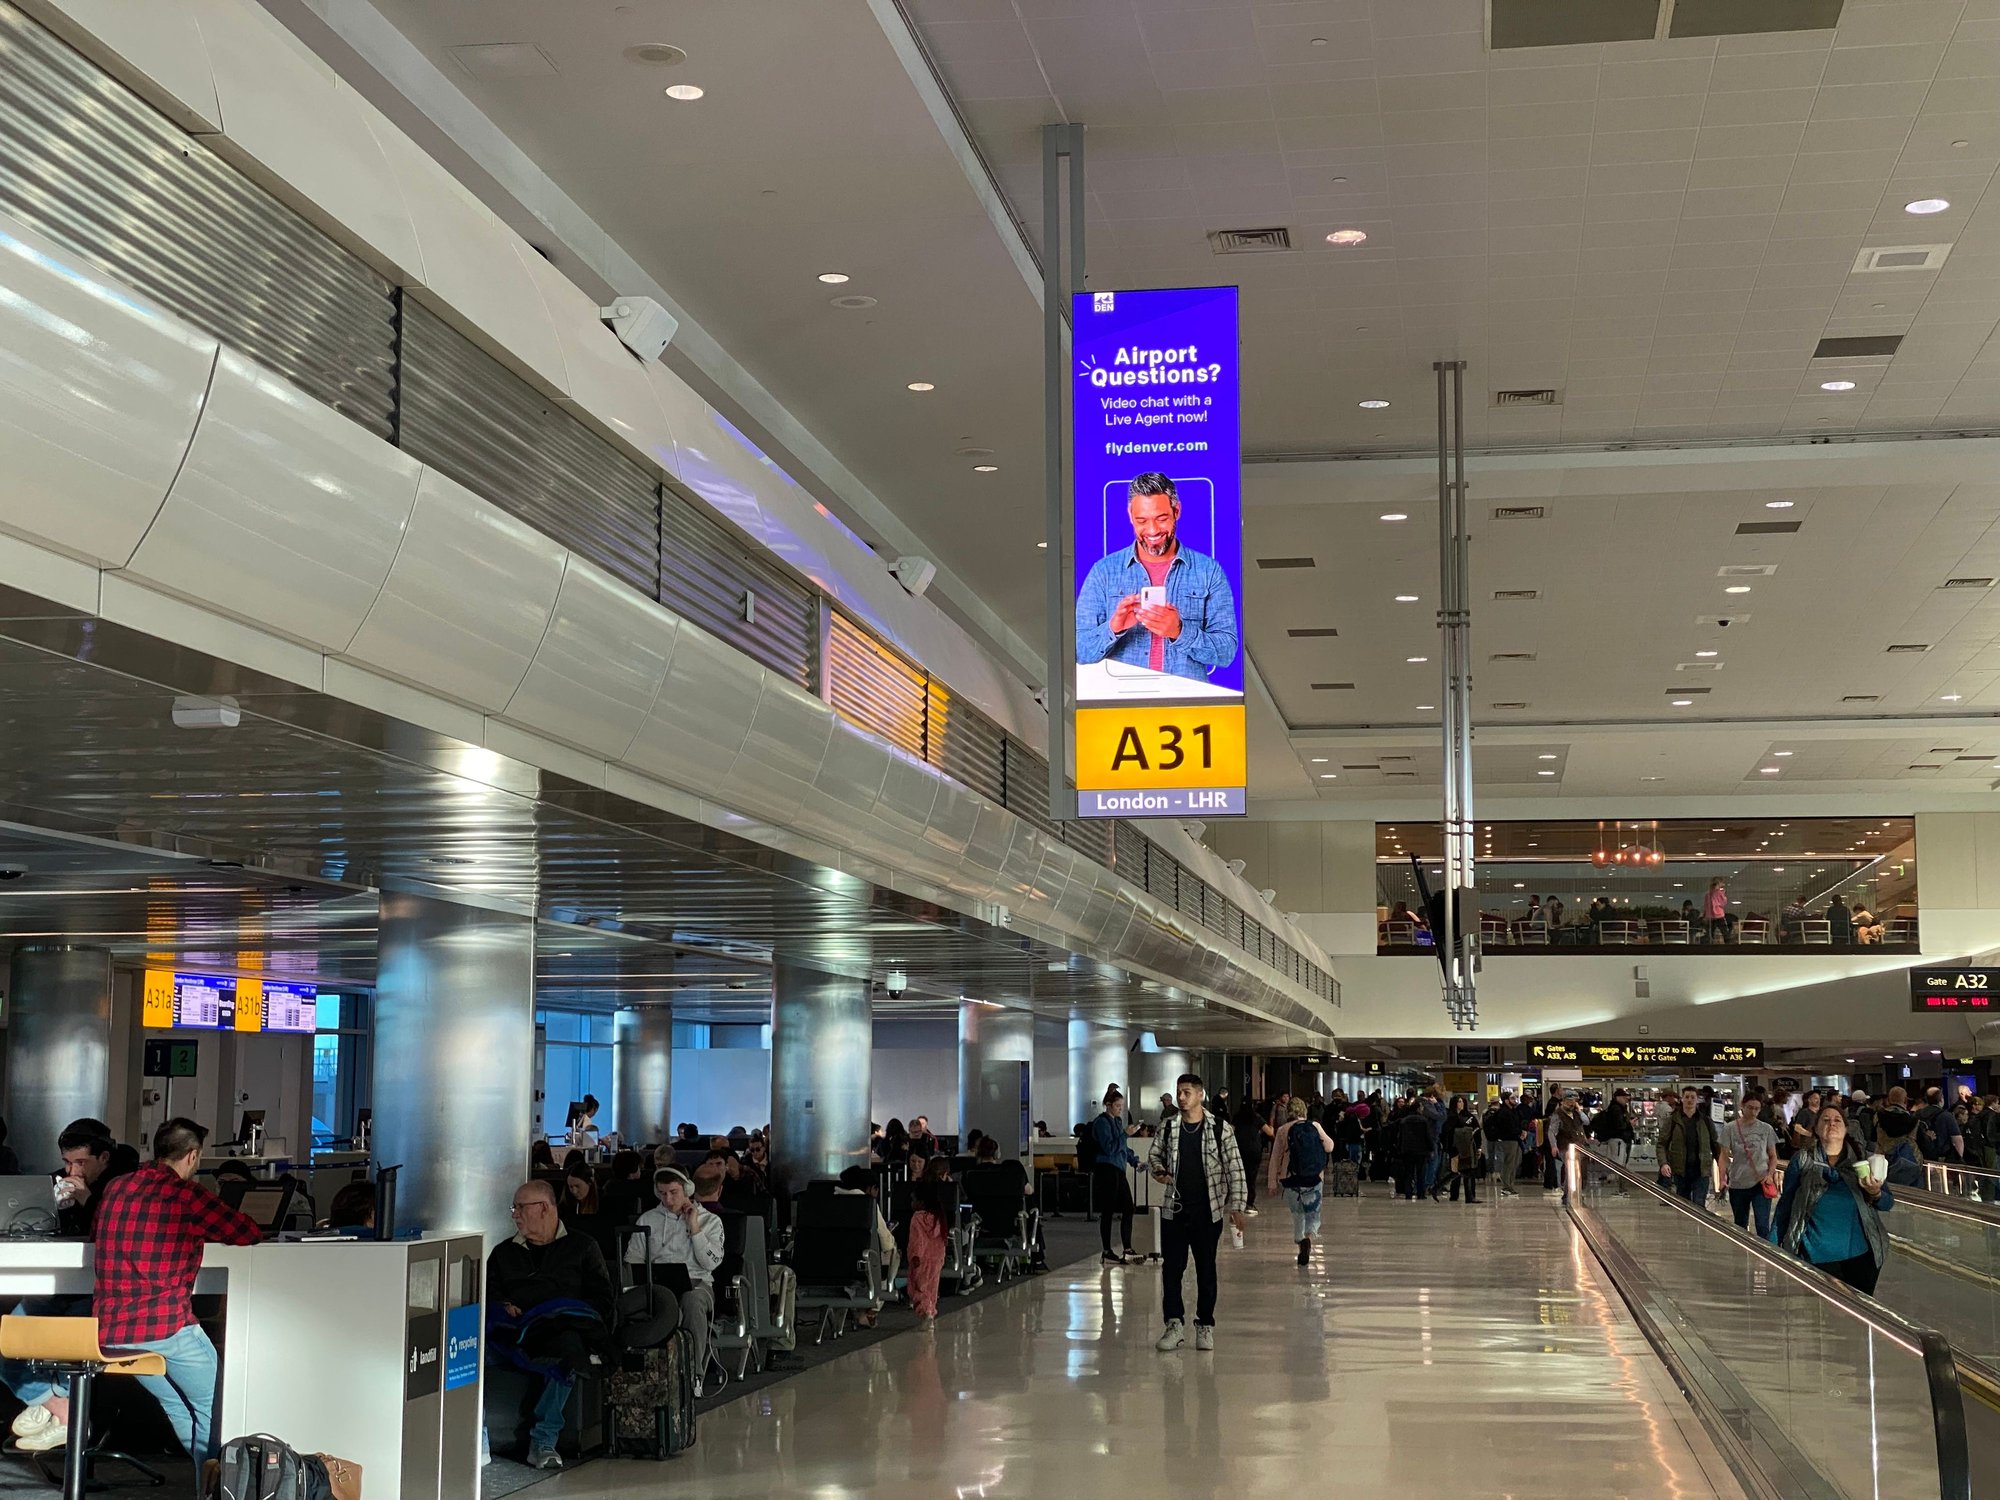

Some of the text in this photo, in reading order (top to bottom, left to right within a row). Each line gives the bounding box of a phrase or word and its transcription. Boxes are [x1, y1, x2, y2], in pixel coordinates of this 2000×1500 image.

[1094, 304, 1114, 312] DEN
[1114, 345, 1198, 367] Airport
[1091, 364, 1221, 387] Questions?
[1101, 395, 1212, 409] Video chat with a
[1105, 410, 1208, 427] Live Agent now!
[1105, 441, 1208, 456] flydenver.com
[1111, 723, 1212, 771] A31
[1097, 792, 1168, 810] London
[1188, 792, 1228, 808] LHR
[1927, 974, 1988, 989] Gate A32
[146, 988, 172, 1010] A31a
[237, 995, 261, 1016] A31b
[156, 1049, 161, 1063] 1
[179, 1050, 188, 1063] 2
[1546, 1045, 1565, 1053] Gates
[1591, 1046, 1620, 1056] Baggage
[1681, 1046, 1697, 1055] A99,
[458, 1336, 477, 1351] recycling
[420, 1347, 436, 1364] landfill
